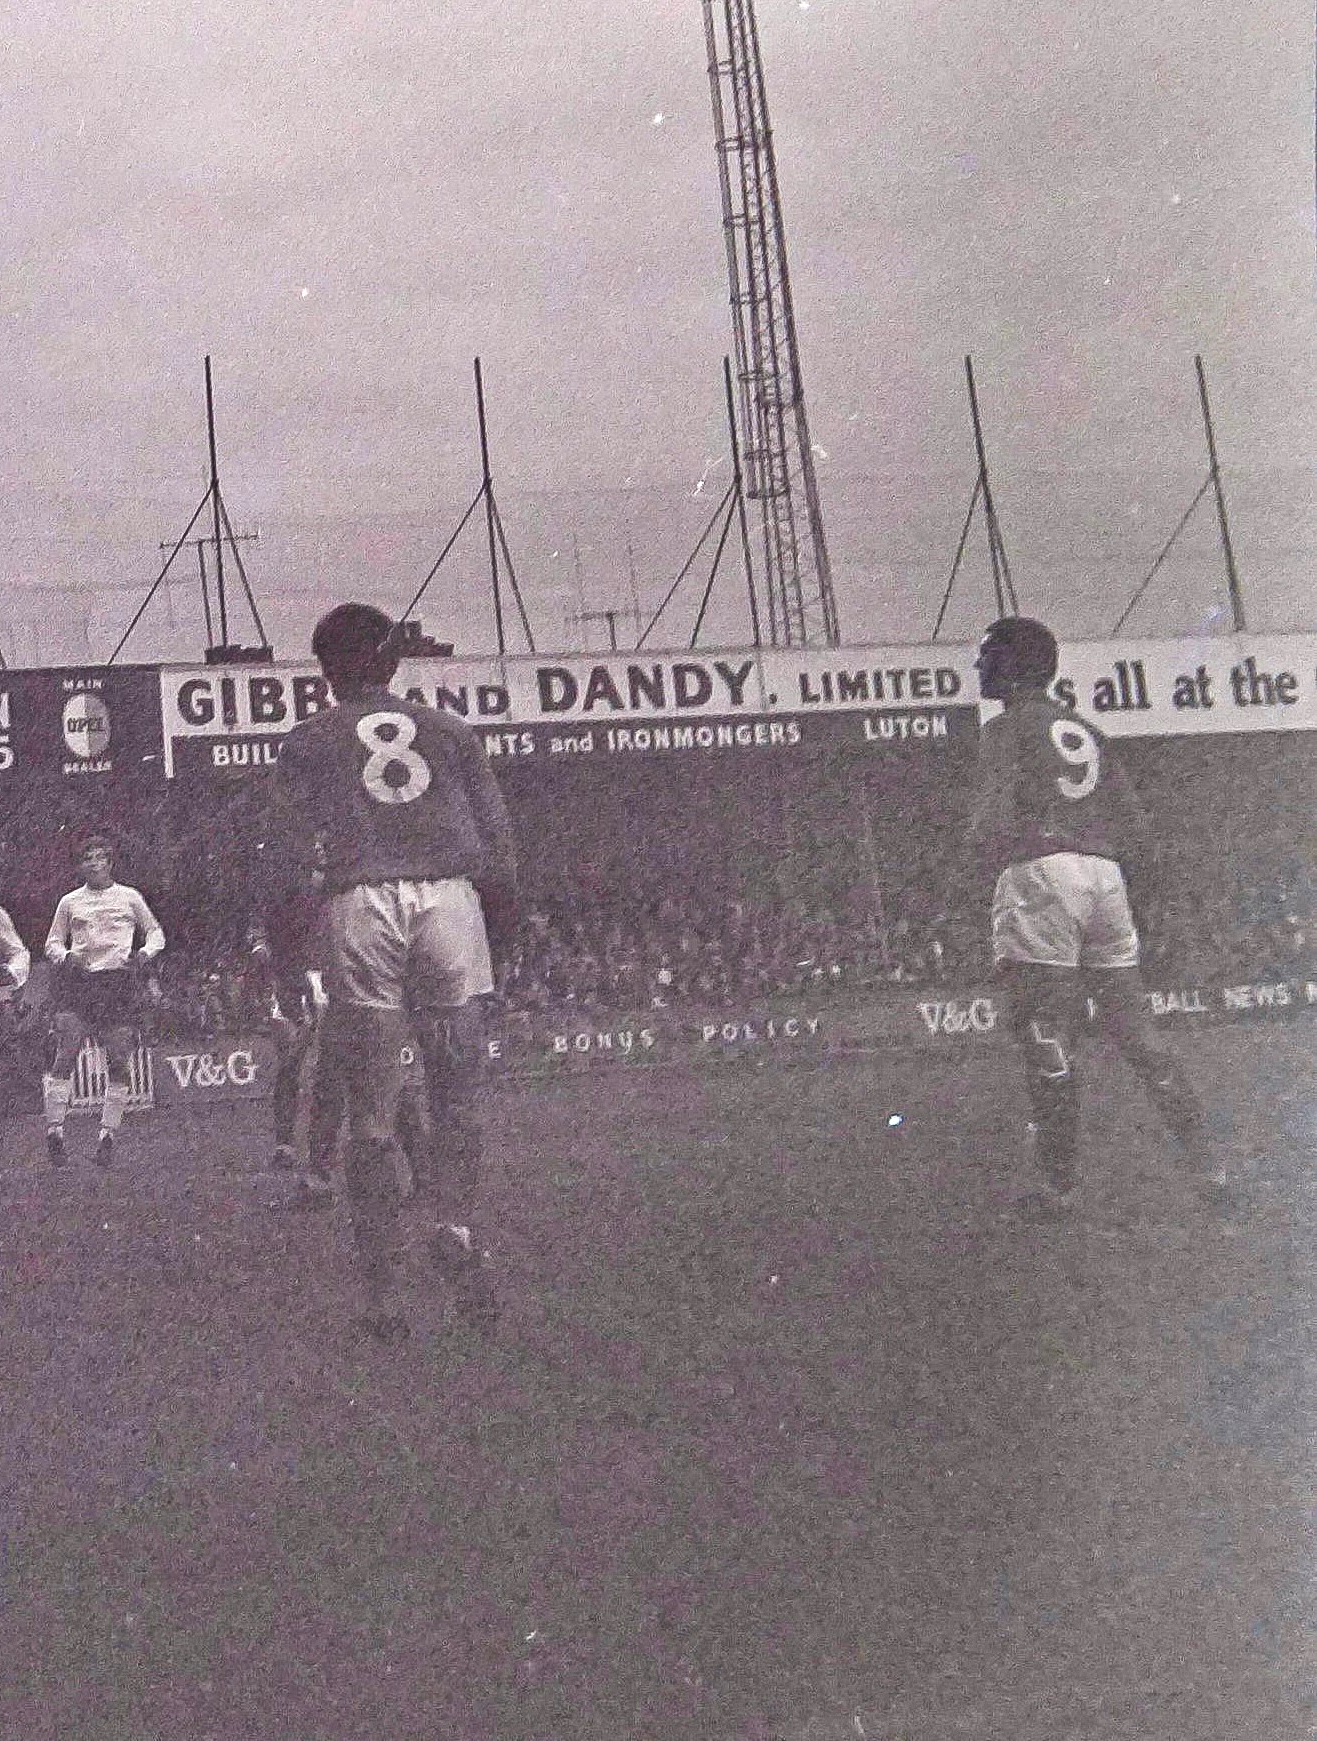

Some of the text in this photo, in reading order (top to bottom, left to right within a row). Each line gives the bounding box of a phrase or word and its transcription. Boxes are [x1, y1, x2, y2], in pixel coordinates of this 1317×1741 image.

[177, 675, 331, 725] GIBB
[801, 667, 961, 703] LIMITED
[1093, 660, 1150, 712] all
[1173, 664, 1214, 708] at
[1231, 656, 1299, 706] the
[213, 742, 283, 767] BUIL
[552, 727, 593, 752] and
[609, 720, 801, 751] IRONMONGERS
[864, 715, 947, 741] LUTON
[357, 711, 432, 802] 8
[1049, 718, 1101, 800] 9
[701, 1017, 821, 1043] POLICY
[919, 998, 998, 1034] V&G
[166, 1049, 259, 1088] V&G
